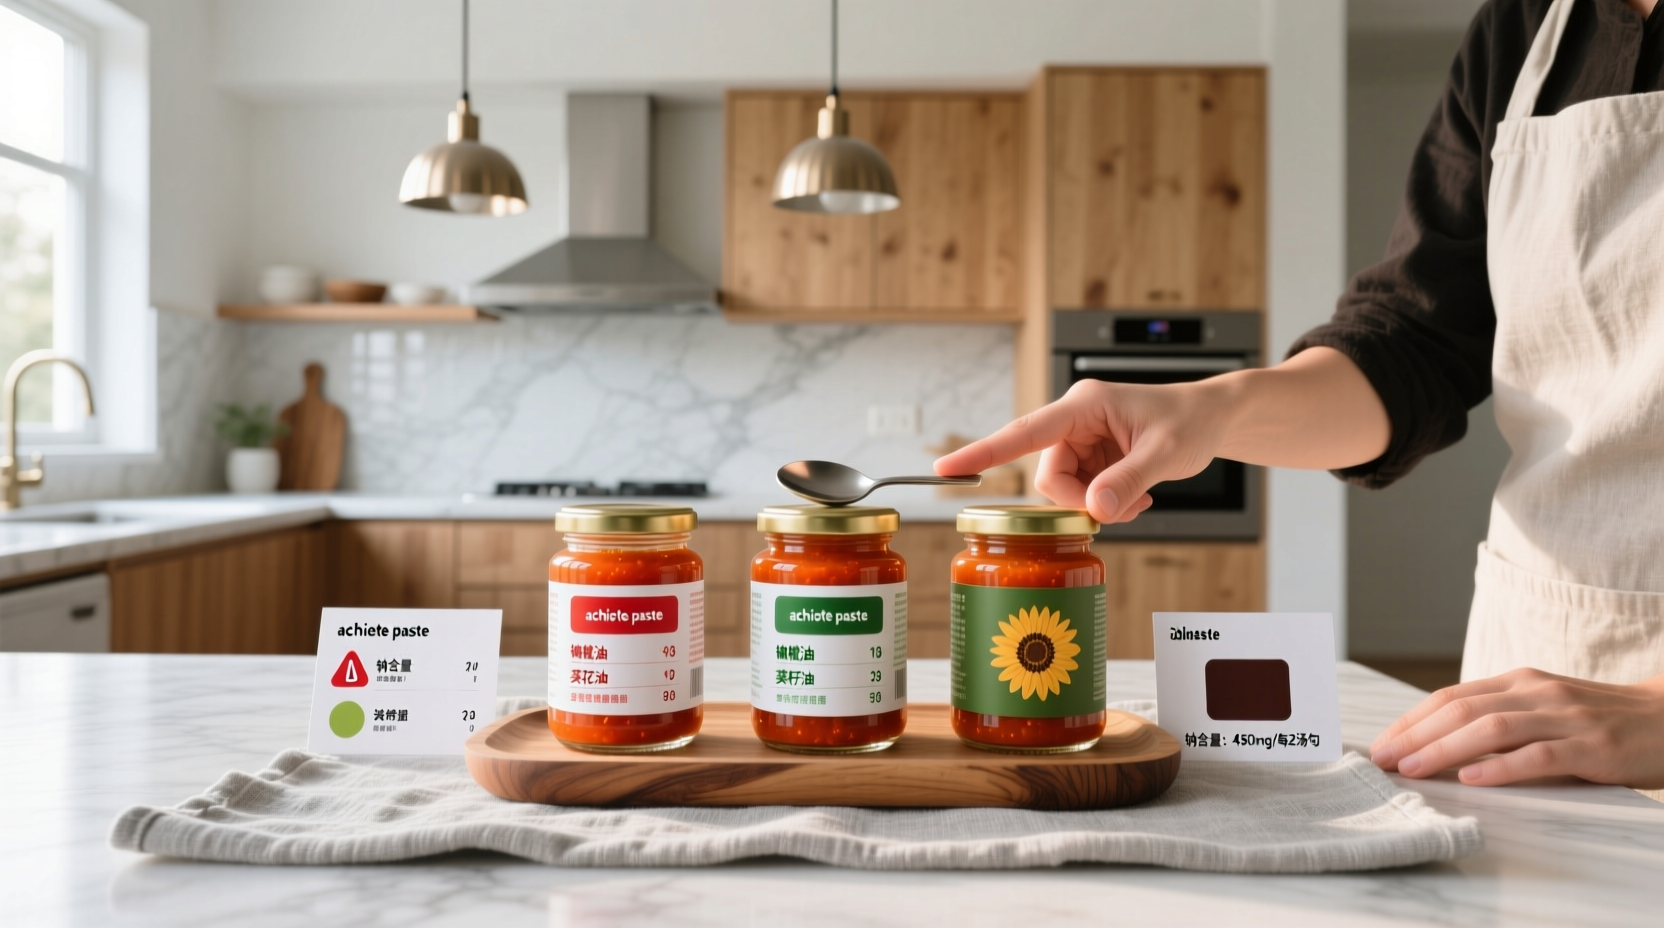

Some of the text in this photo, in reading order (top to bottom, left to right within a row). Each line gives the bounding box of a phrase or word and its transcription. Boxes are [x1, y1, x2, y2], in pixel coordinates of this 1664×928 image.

[632, 610, 663, 625] paste
[835, 609, 868, 625] paste
[392, 625, 430, 640] paste
